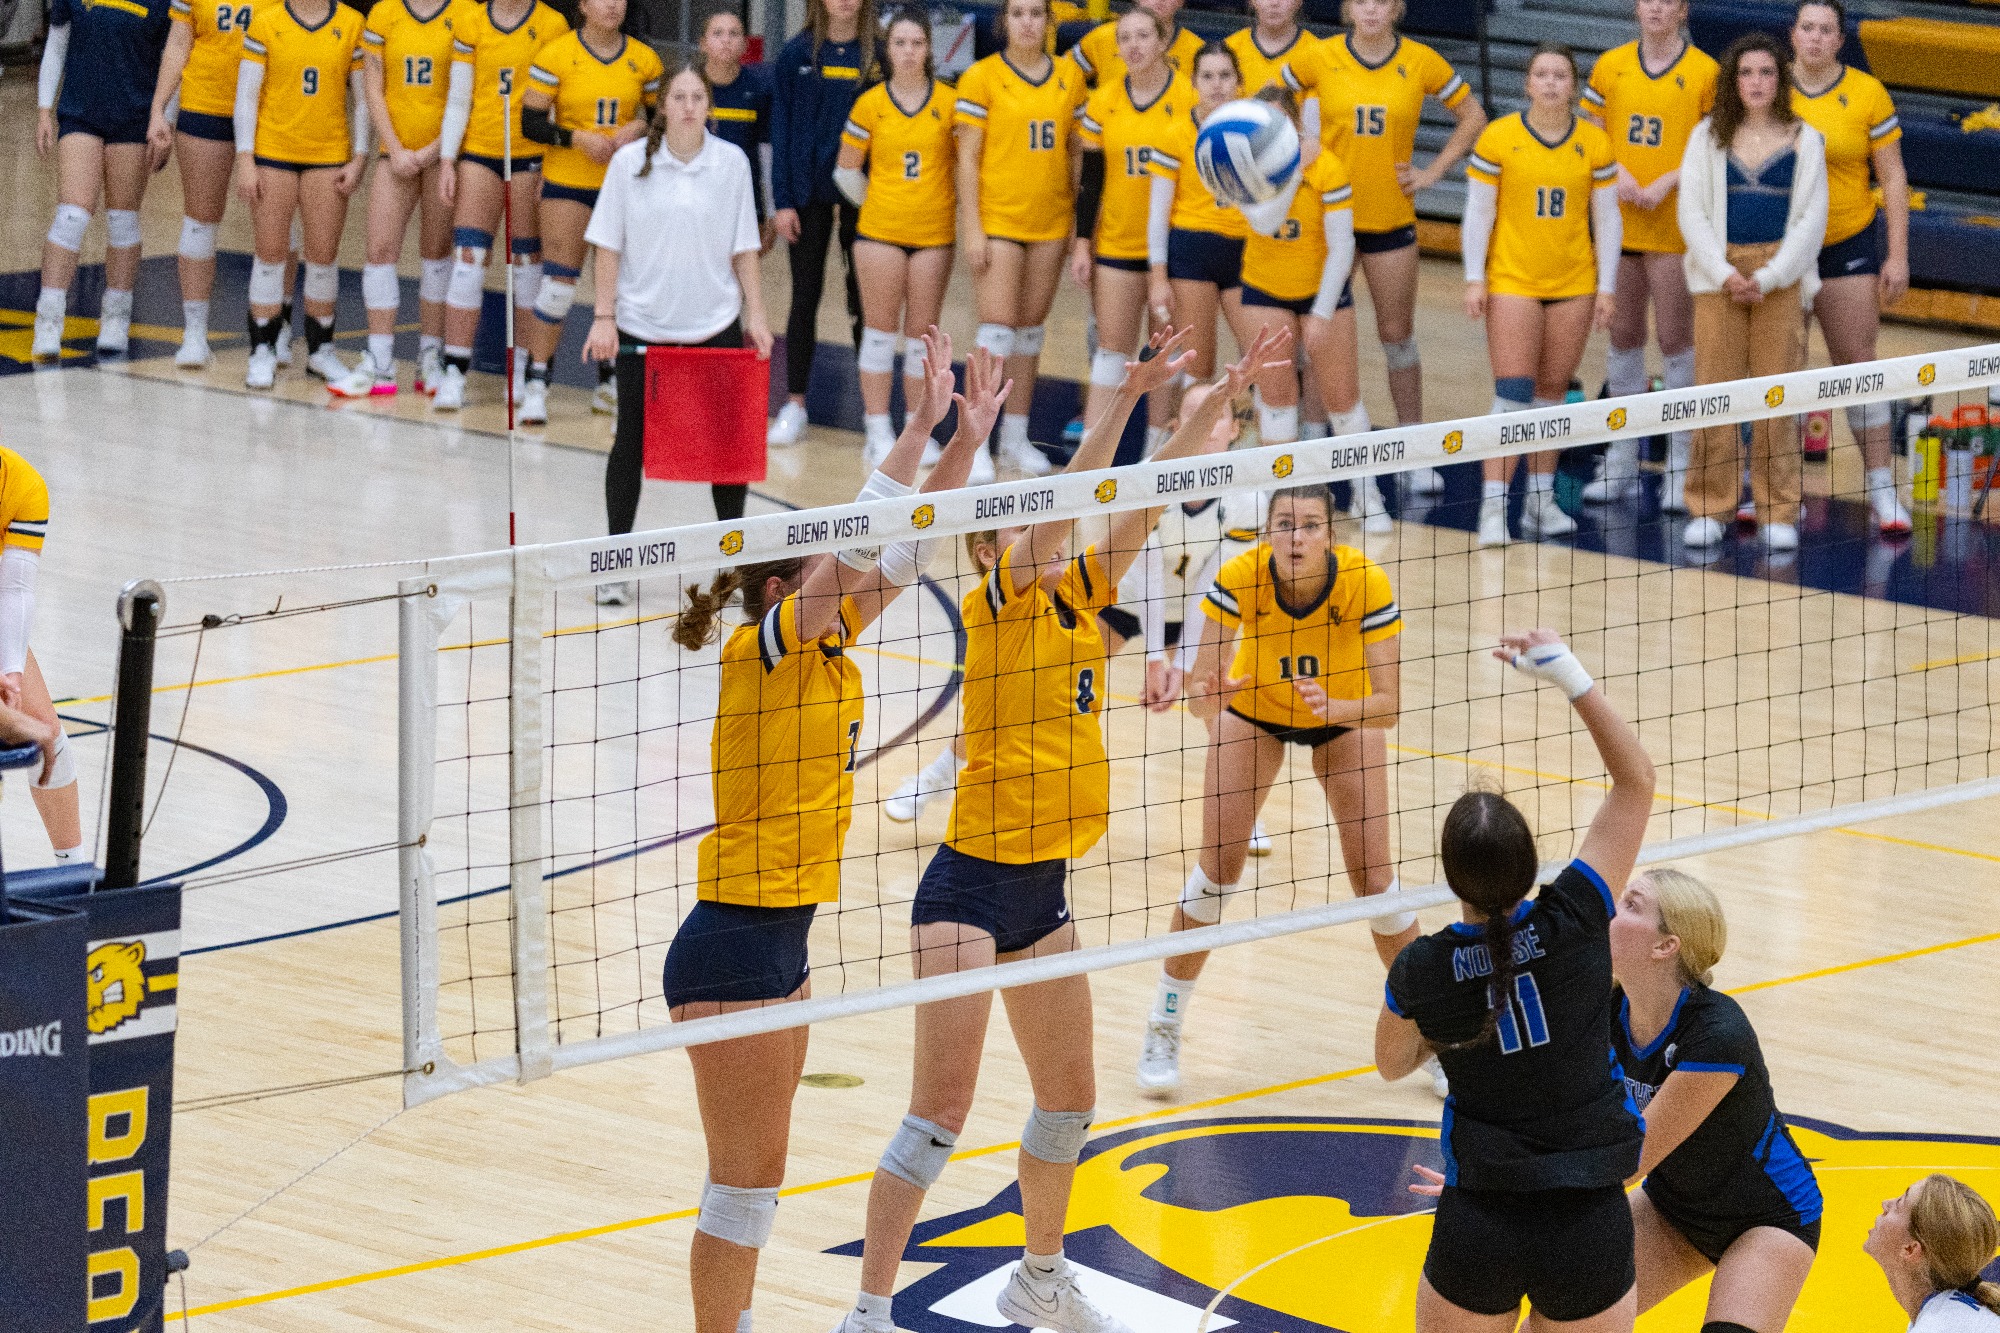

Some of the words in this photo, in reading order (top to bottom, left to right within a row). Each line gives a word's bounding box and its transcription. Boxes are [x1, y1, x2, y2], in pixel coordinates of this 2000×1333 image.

[216, 5, 252, 32] 24
[303, 67, 318, 95] 9
[405, 56, 433, 85] 12
[499, 68, 514, 95] 5
[597, 98, 618, 125] 11
[1355, 105, 1387, 137] 15
[1028, 121, 1055, 149] 16
[1628, 113, 1663, 147] 23
[904, 151, 920, 179] 2
[1125, 146, 1152, 176] 19
[1536, 187, 1566, 218] 18
[1818, 377, 1851, 399] BUENA
[1855, 372, 1884, 394] VISTA
[1661, 400, 1696, 422] BUENA
[1700, 395, 1730, 416] VISTA
[1500, 422, 1536, 445] BUENA
[1539, 417, 1571, 439] VISTA
[1331, 447, 1368, 469] BUENA
[1372, 441, 1405, 463] VISTA
[1157, 470, 1195, 494] BUENA
[1200, 465, 1234, 488] VISTA
[975, 495, 1015, 519] BUENA
[1019, 489, 1054, 512] VISTA
[786, 520, 829, 545] BUENA
[832, 515, 870, 539] VISTA
[590, 547, 634, 573] BUENA
[637, 541, 677, 566] VISTA
[1278, 655, 1321, 680] 10
[1074, 667, 1096, 714] 8
[844, 719, 861, 773] 7
[1453, 923, 1547, 982] NOSE
